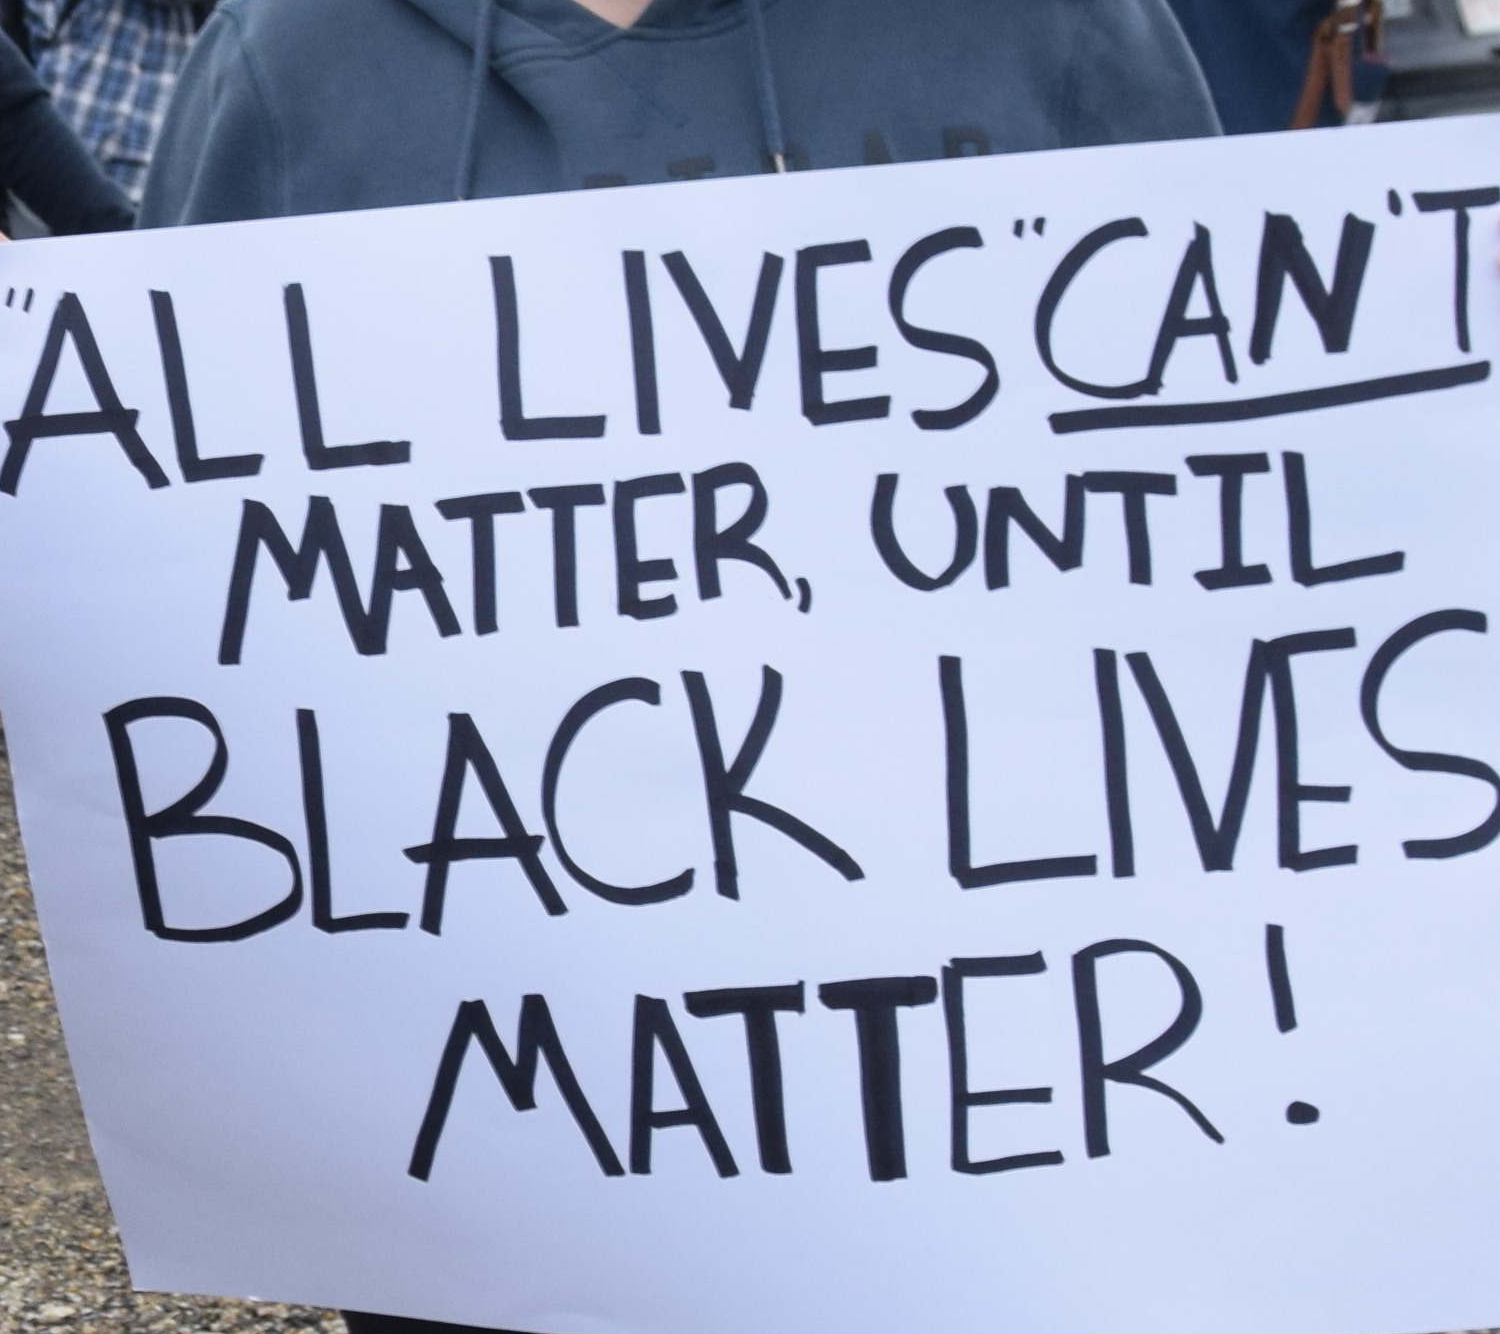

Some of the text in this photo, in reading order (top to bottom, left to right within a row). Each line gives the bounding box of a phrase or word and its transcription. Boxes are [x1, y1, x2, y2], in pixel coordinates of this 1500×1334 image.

[217, 451, 1406, 666] MATTER, UNTIL
[101, 664, 865, 944] BLACK
[407, 923, 1321, 1183] MATTER!
